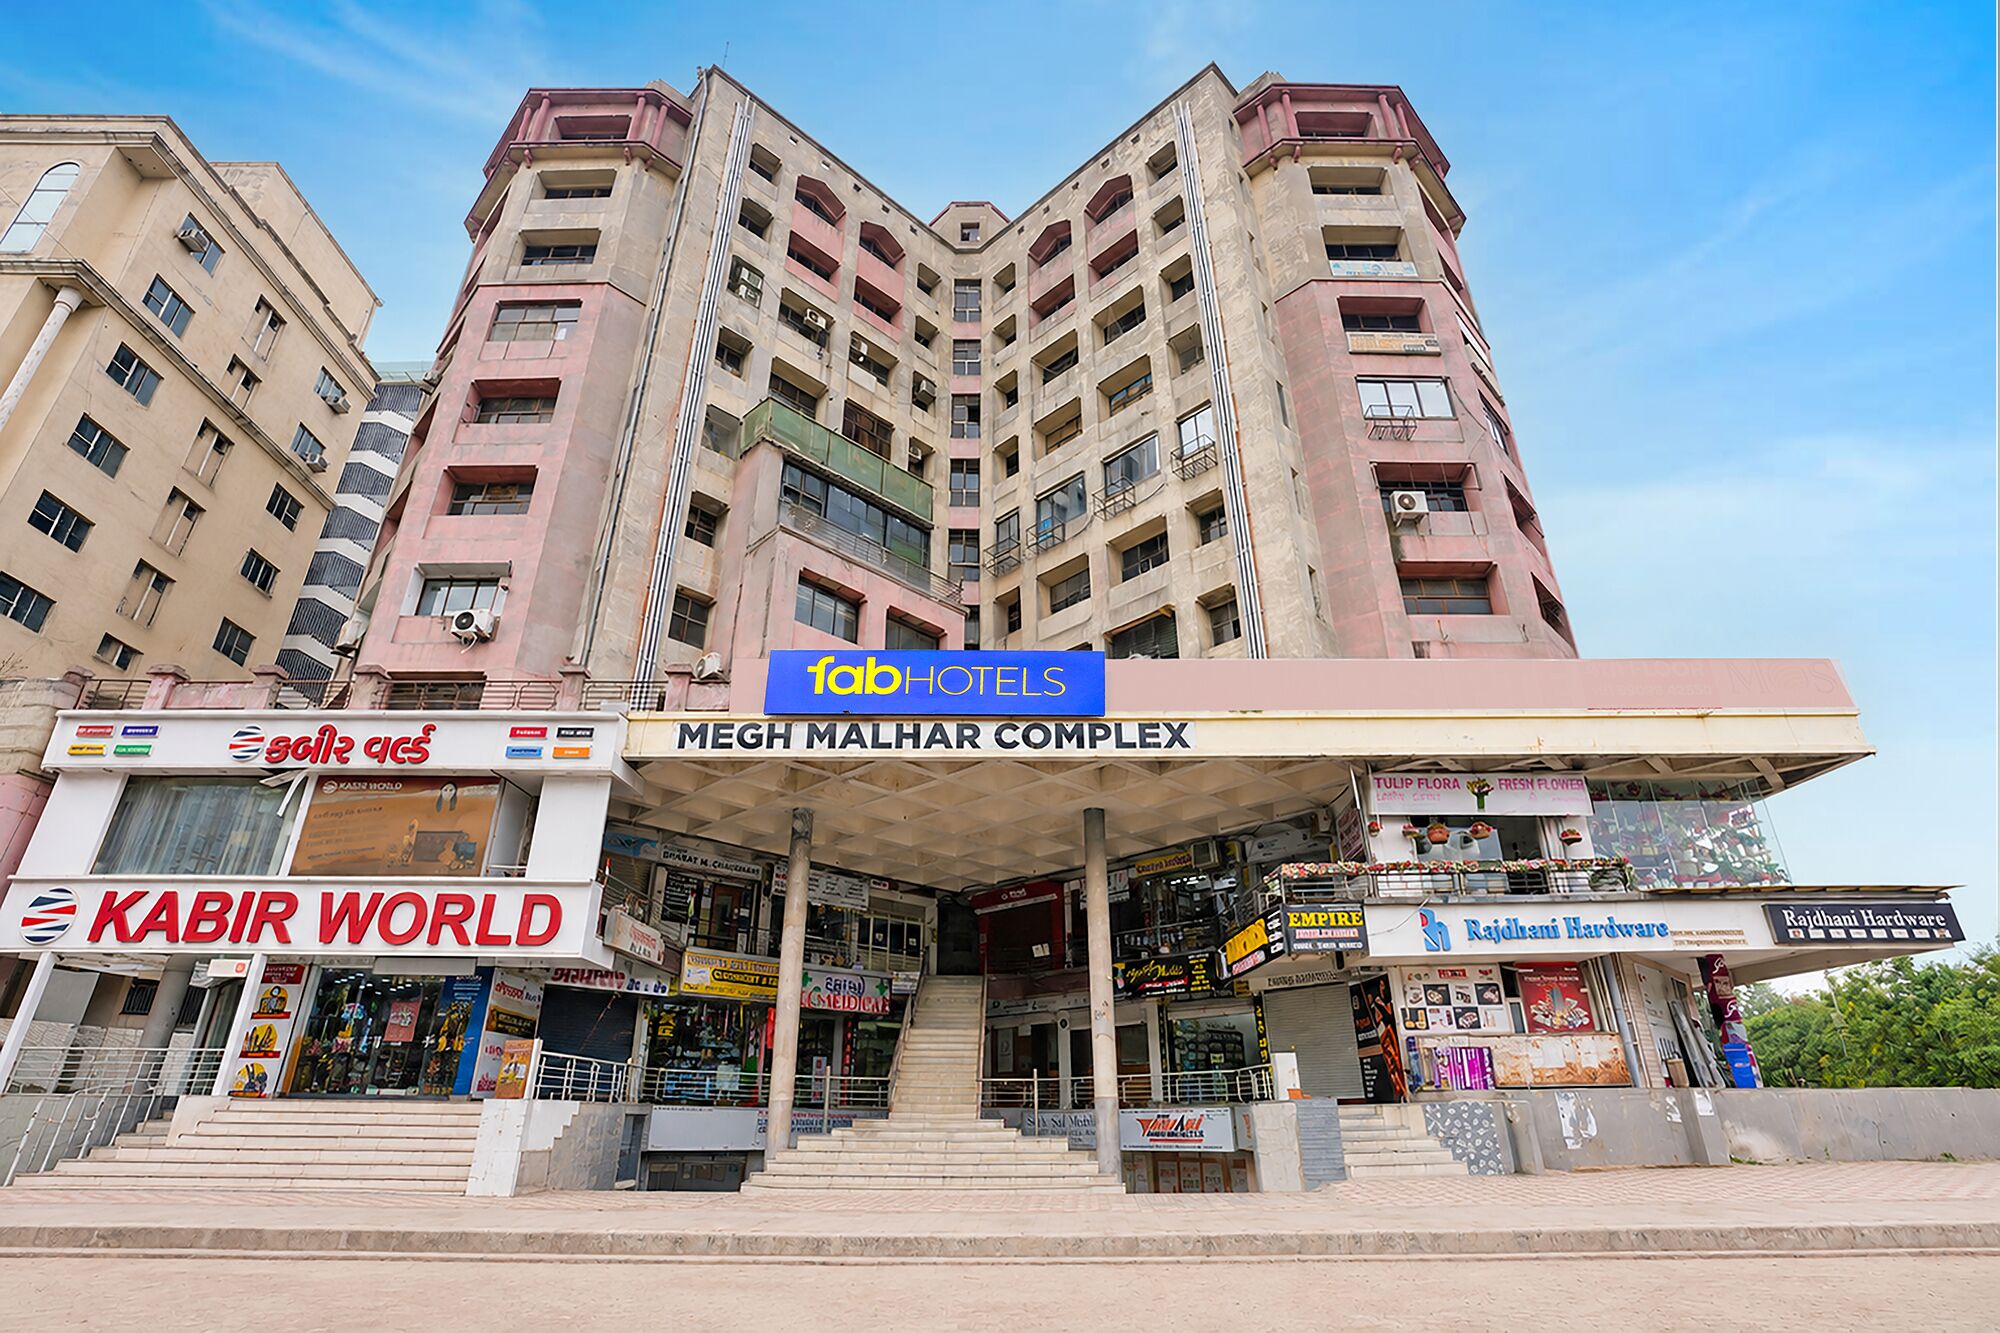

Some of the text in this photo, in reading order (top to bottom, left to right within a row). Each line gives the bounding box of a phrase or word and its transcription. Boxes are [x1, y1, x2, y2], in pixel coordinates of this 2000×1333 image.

[265, 724, 355, 764] કબીર
[677, 721, 1191, 750] MEGH MALHAR COMPLEX
[1375, 777, 1413, 789] TULIP
[1417, 777, 1461, 789] FLORA
[1537, 778, 1585, 791] FLOWER
[87, 890, 563, 946] KABIR WORLD
[1287, 911, 1364, 927] EMPIRE
[1464, 917, 1560, 944] Rajdhani
[1563, 916, 1669, 939] Hardware
[1782, 908, 1946, 929] Rajdhani Hardware
